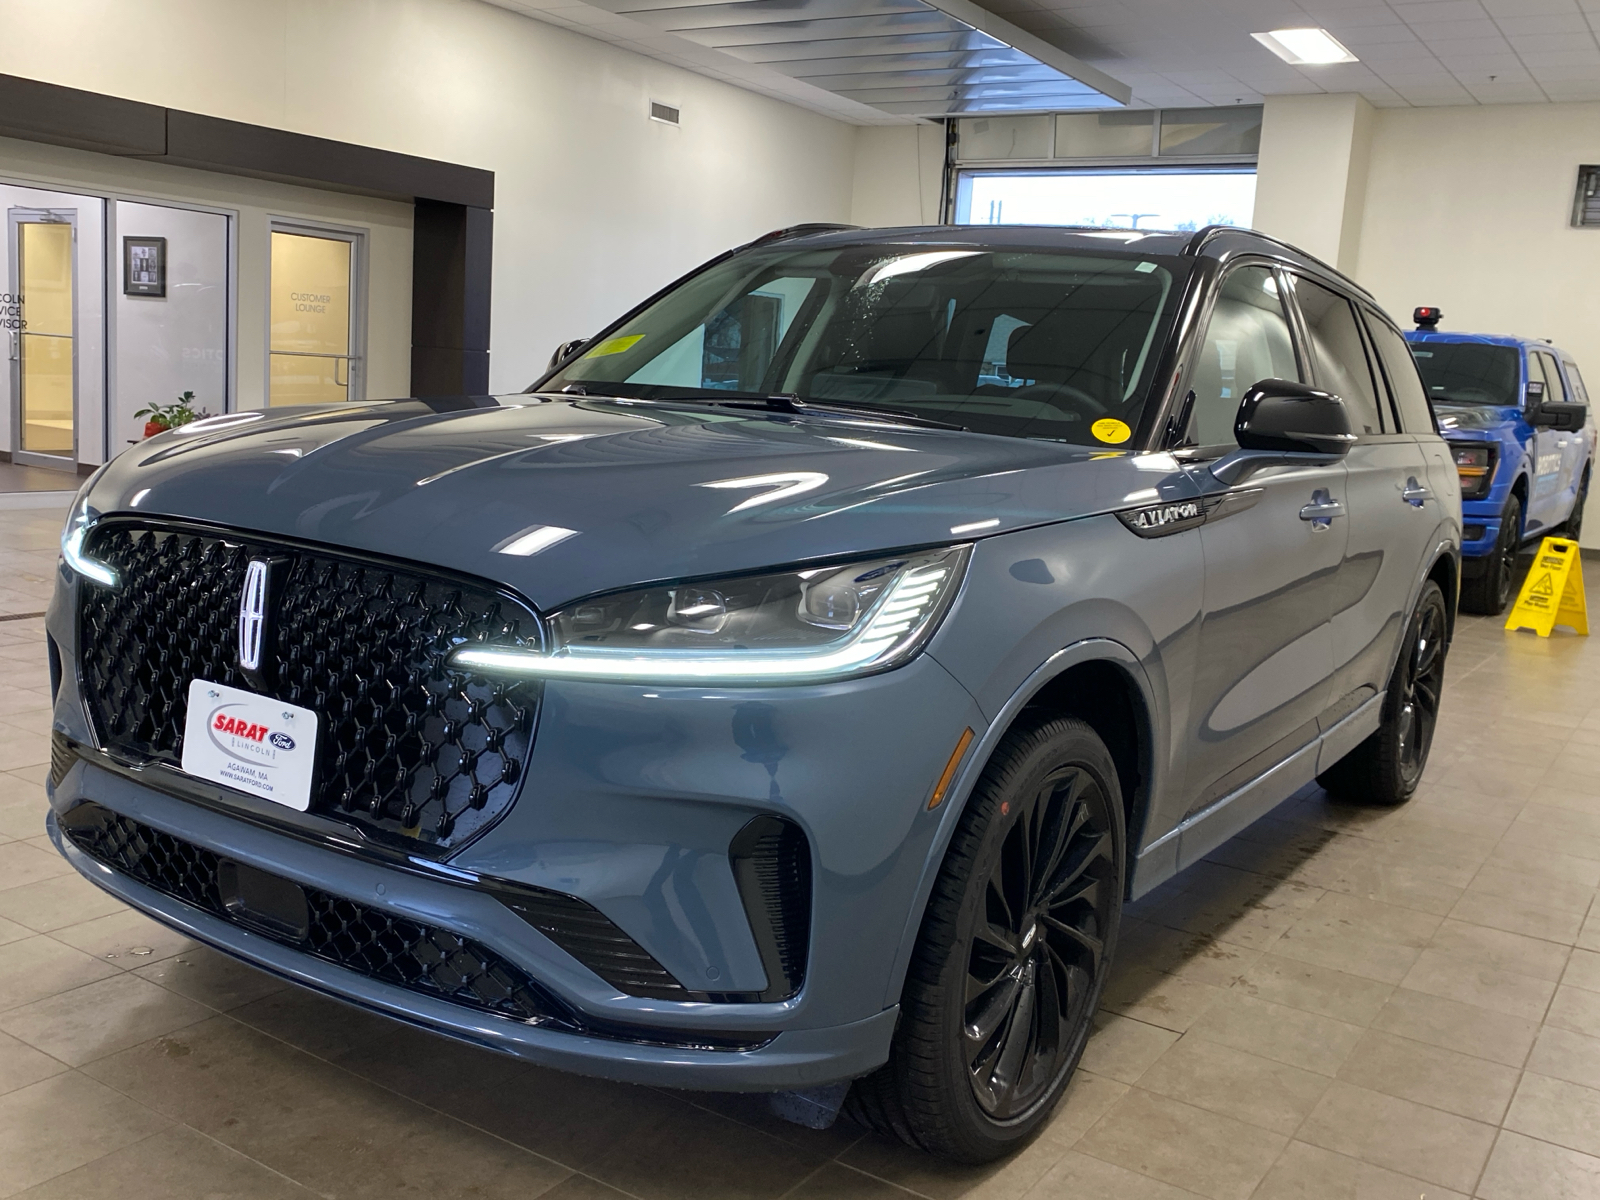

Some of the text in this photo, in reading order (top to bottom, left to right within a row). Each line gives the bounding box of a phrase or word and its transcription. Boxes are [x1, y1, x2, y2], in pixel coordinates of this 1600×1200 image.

[290, 292, 331, 304] CUSTOMER
[295, 303, 326, 314] LOUNGE
[1138, 503, 1198, 527] AVIATOR
[213, 714, 269, 742] SARAT
[237, 741, 270, 756] LINCOLN
[273, 734, 292, 749] Ford
[220, 769, 274, 791] WWW.SARATFORD.COM
[227, 762, 268, 781] AGAWAM, MA
